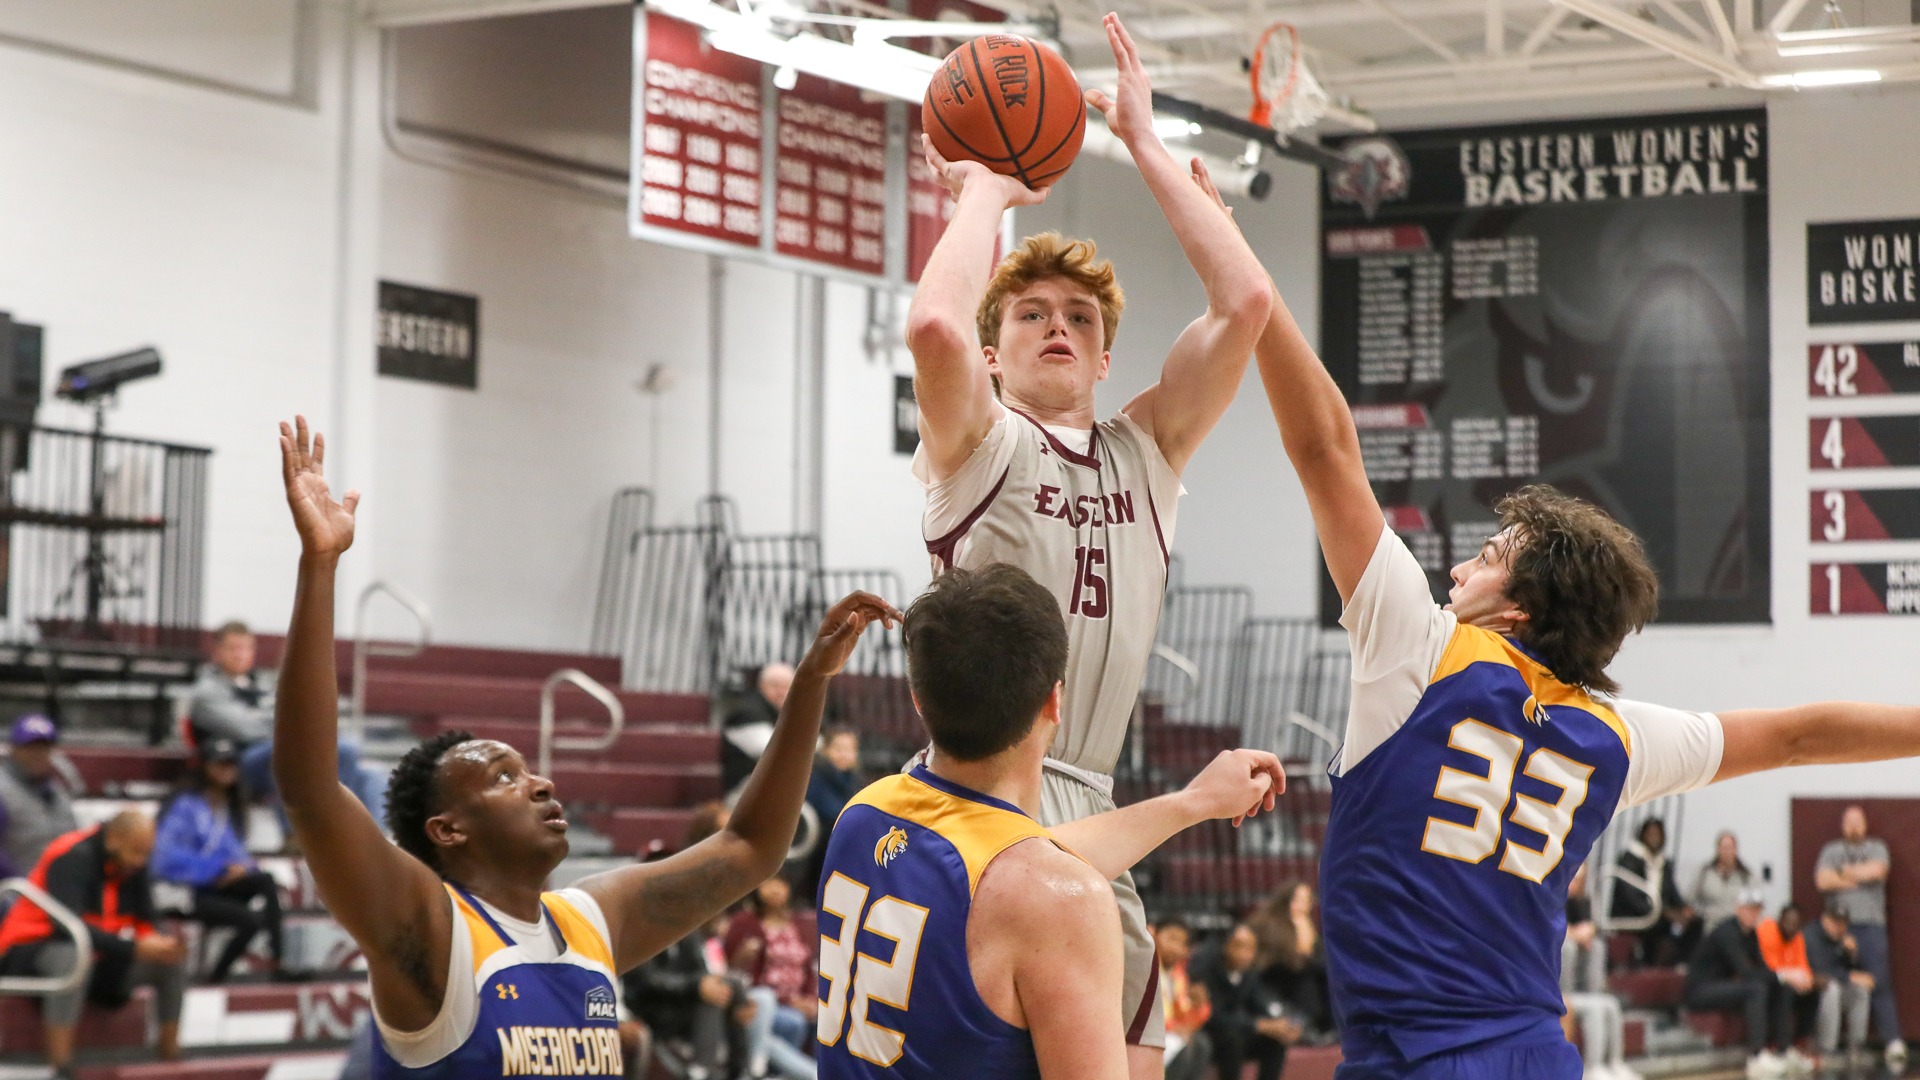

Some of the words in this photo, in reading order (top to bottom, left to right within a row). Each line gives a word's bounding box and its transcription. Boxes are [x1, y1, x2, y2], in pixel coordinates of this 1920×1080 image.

[986, 35, 1022, 50] HE
[992, 54, 1030, 109] ROCK
[1460, 133, 1596, 175] EASTERN
[1613, 123, 1759, 164] WOMEN'S
[1464, 157, 1758, 207] BASKETBALL
[1844, 233, 1920, 269] WOM
[1820, 269, 1917, 306] BASKE
[1815, 345, 1858, 395] 42
[1821, 418, 1845, 469] 4
[1823, 491, 1846, 542] 3
[1069, 546, 1109, 619] 15
[1825, 564, 1841, 615] 1
[1421, 717, 1596, 884] 33
[817, 870, 930, 1068] 32
[588, 1002, 615, 1018] MAC
